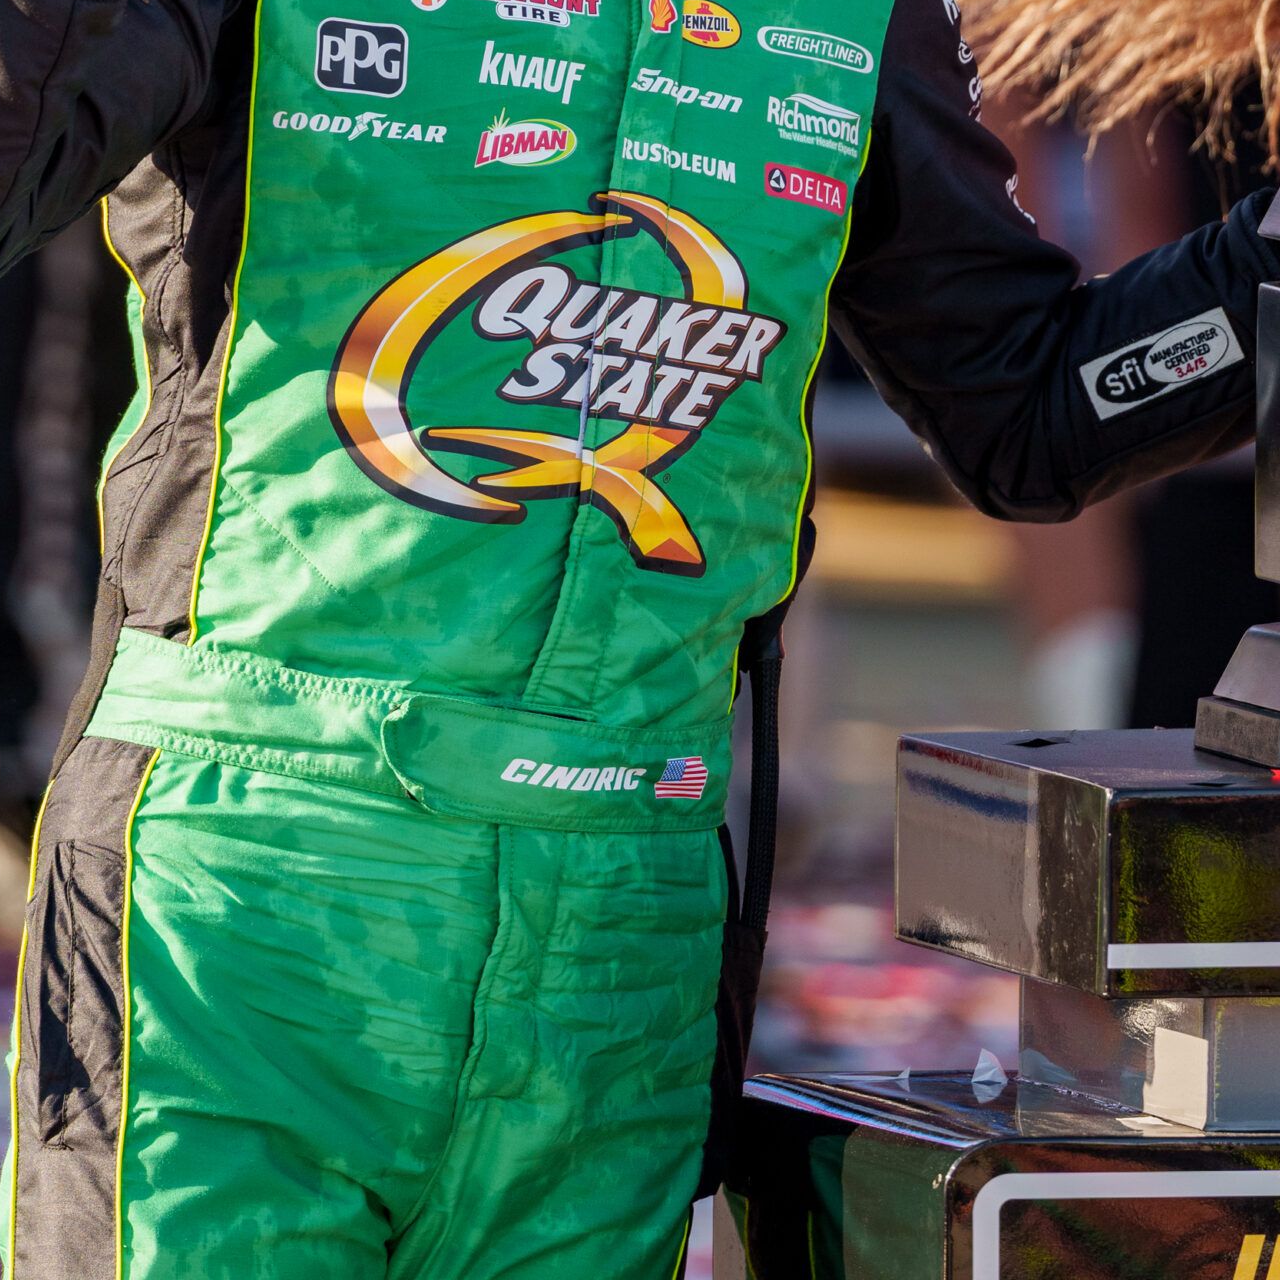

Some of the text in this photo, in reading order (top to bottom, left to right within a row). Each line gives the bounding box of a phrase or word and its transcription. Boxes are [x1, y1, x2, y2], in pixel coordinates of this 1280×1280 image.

[503, 4, 562, 24] TIRE
[321, 28, 401, 85] PPG
[770, 33, 864, 66] FREIGHTLINER
[479, 40, 586, 104] KNAUF
[272, 110, 447, 143] GOODYEAR
[767, 95, 860, 145] Richmond
[474, 128, 570, 168] LIBMAN
[790, 173, 841, 209] DELTA
[478, 265, 782, 375] QUAKER
[1149, 327, 1219, 365] MANUFACTURER
[1164, 342, 1211, 370] CERTIFIED
[501, 342, 736, 428] STATE
[1105, 357, 1147, 396] sfi
[1174, 357, 1208, 378] 3.4/5
[500, 758, 647, 791] CINDRIC
